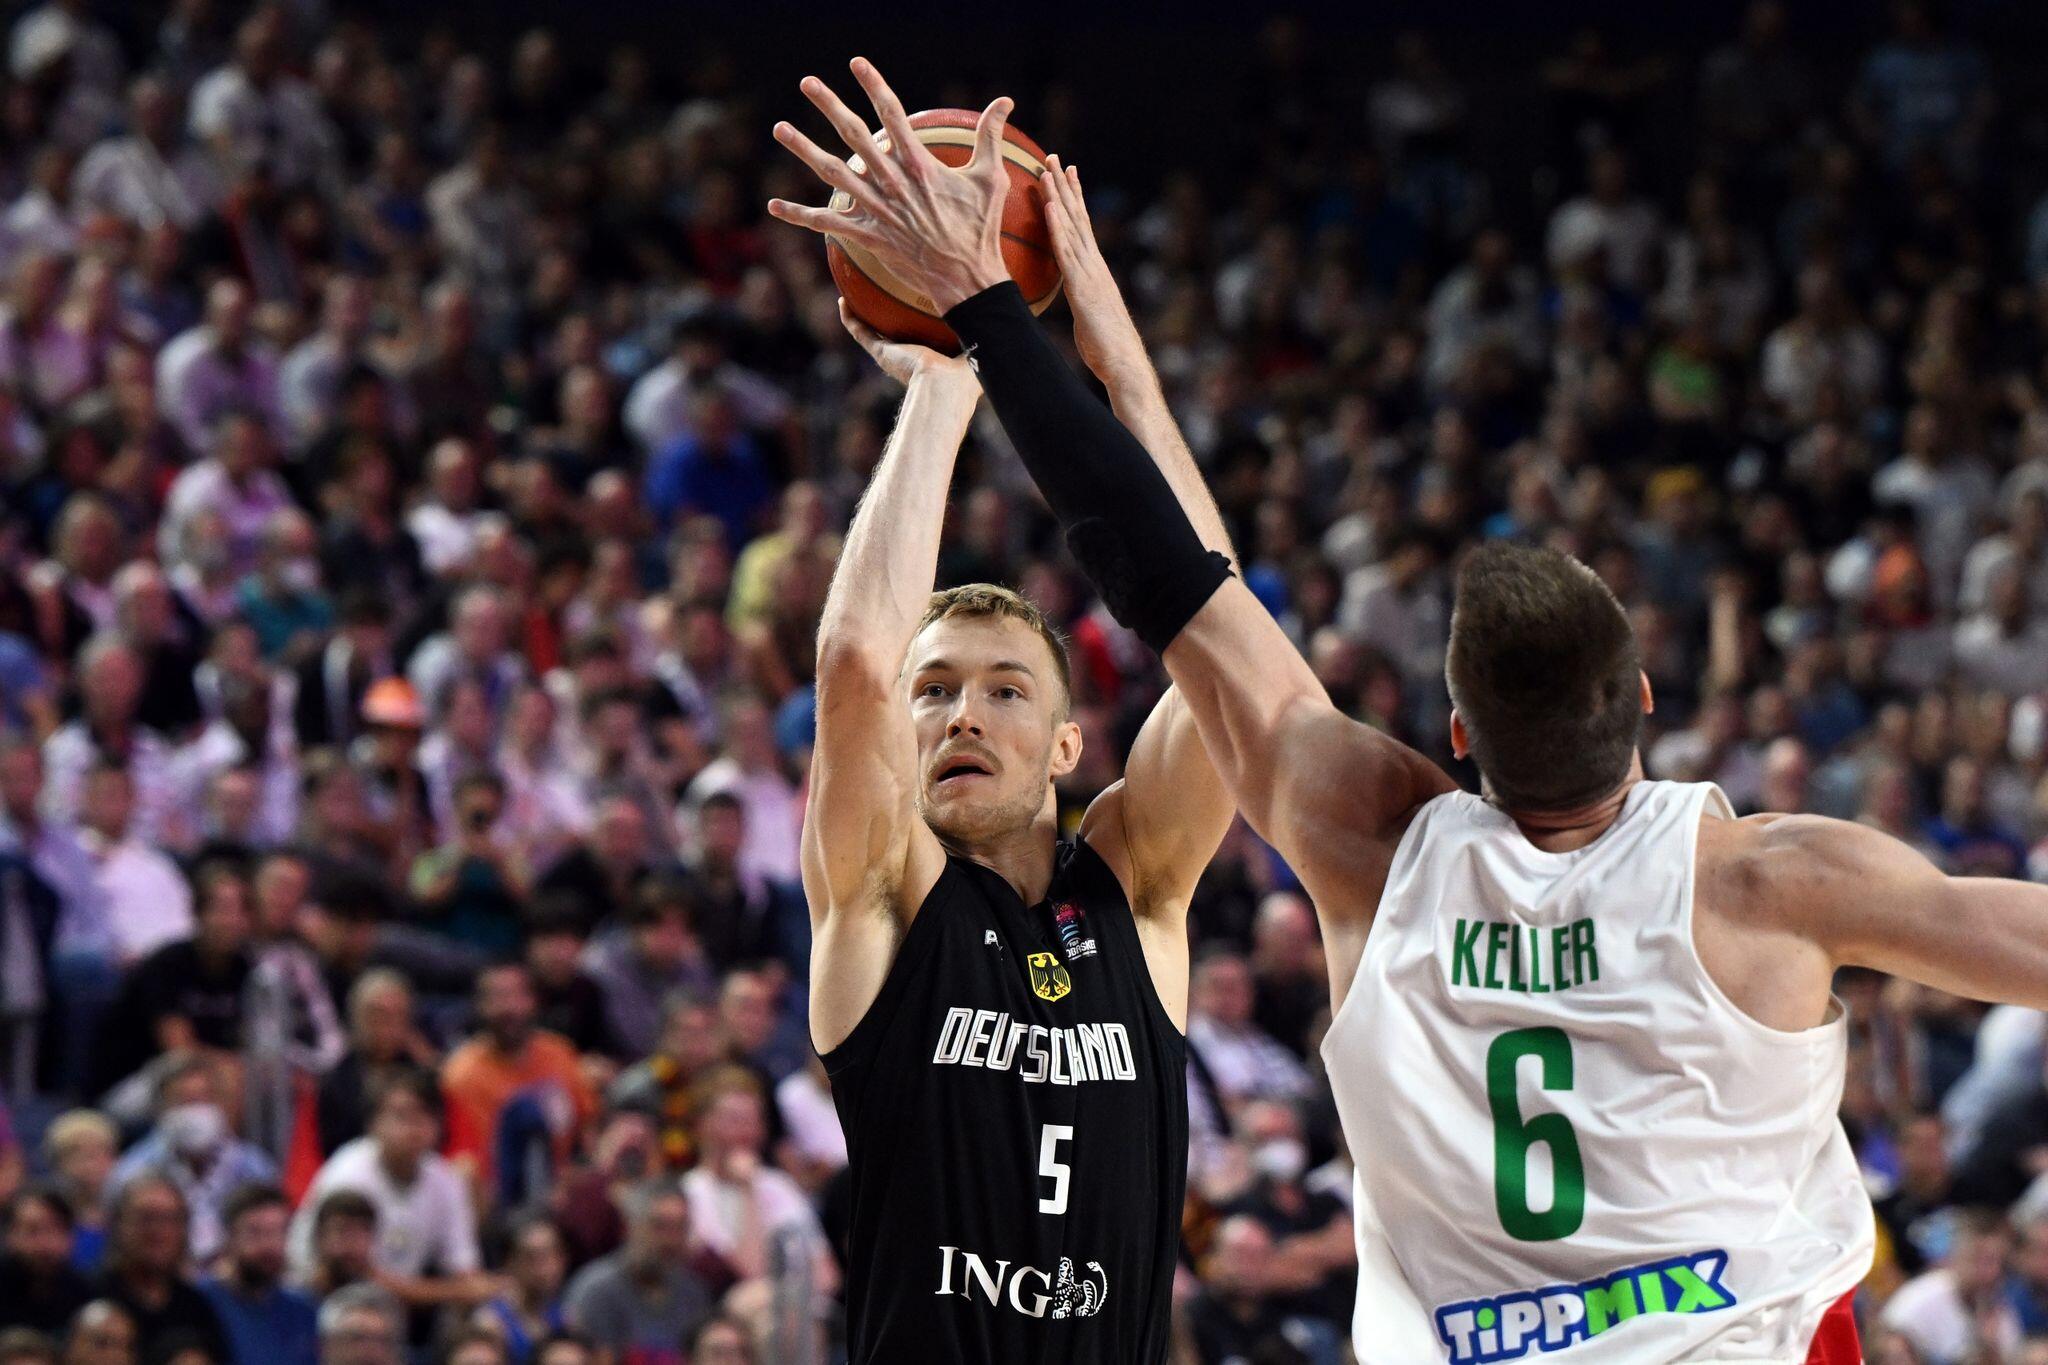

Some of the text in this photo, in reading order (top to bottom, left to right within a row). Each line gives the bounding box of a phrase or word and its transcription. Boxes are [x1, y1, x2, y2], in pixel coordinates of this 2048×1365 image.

[1452, 918, 1600, 993] KELLER
[1039, 1124, 1074, 1215] 5
[1487, 1026, 1587, 1241] 6
[934, 1246, 1053, 1320] ING
